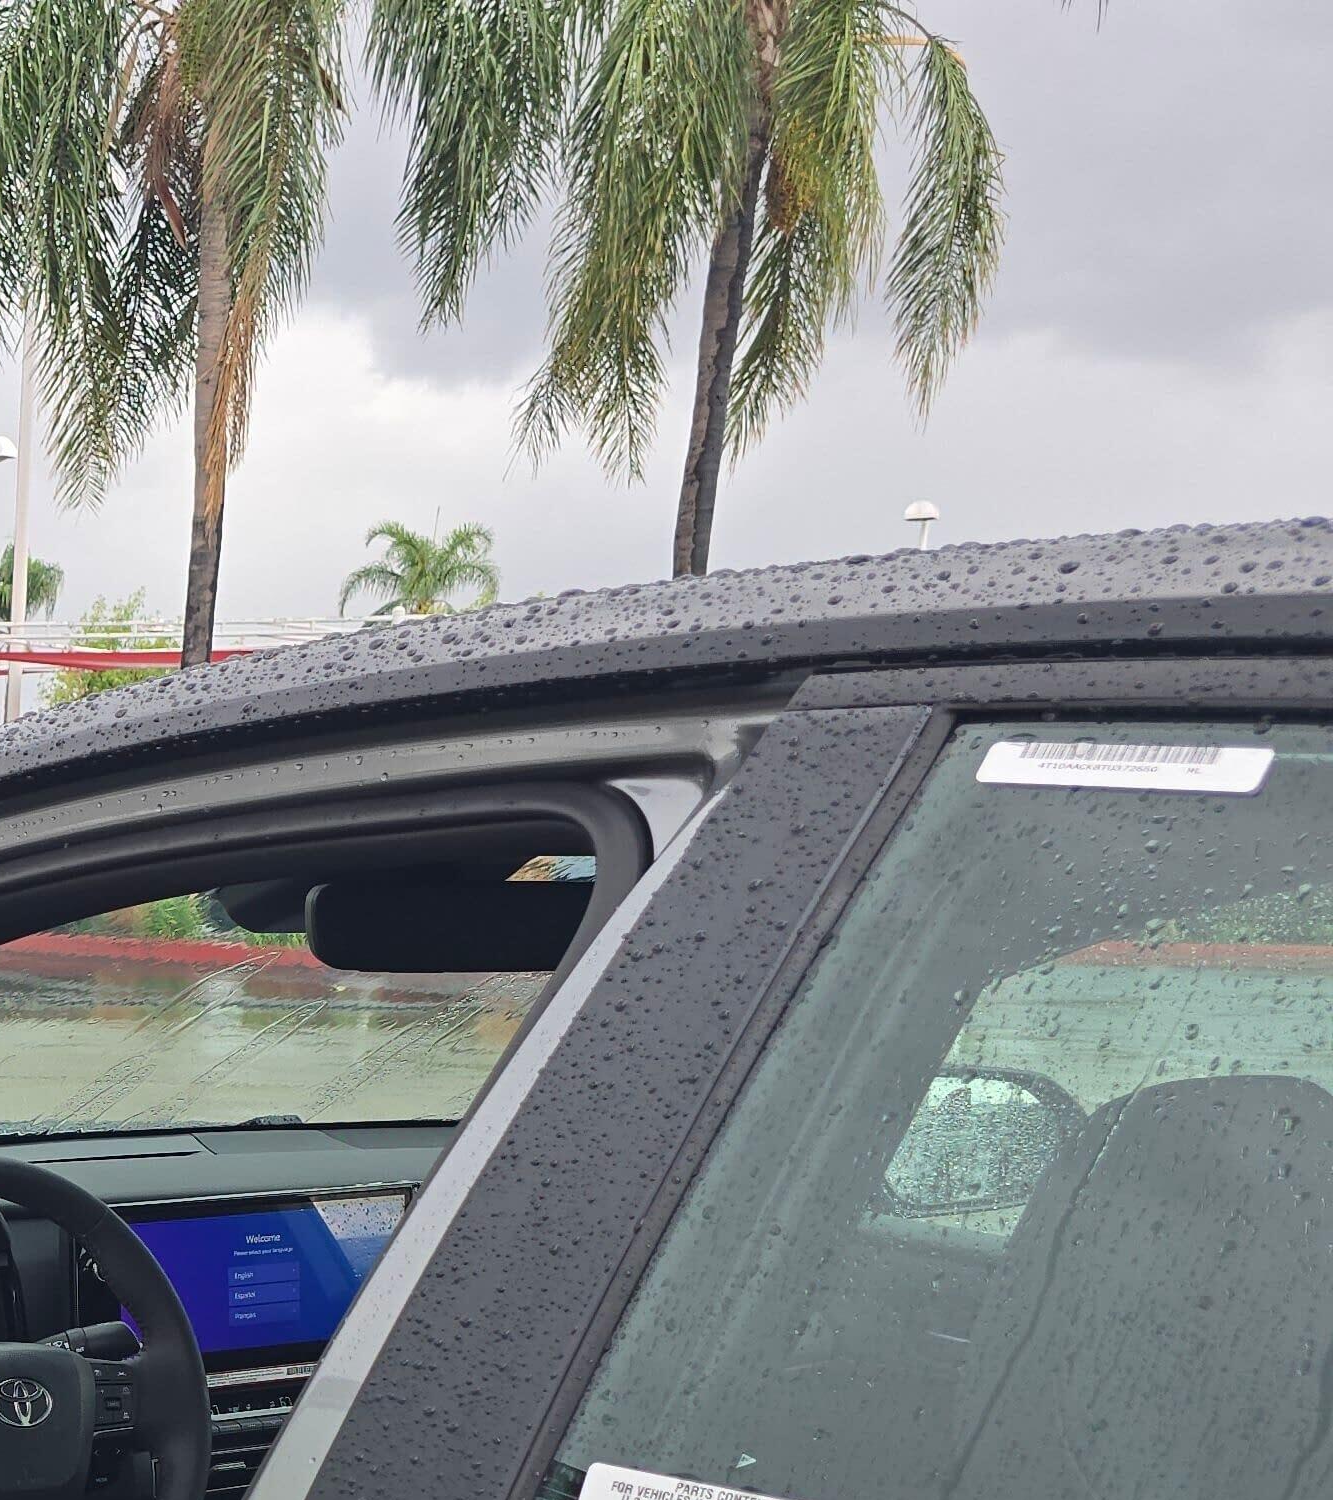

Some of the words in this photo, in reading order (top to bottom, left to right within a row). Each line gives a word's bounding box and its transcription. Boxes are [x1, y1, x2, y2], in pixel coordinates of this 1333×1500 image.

[245, 1233, 281, 1244] Welcome
[610, 1480, 634, 1495] FOR
[674, 1481, 714, 1500] PARTS
